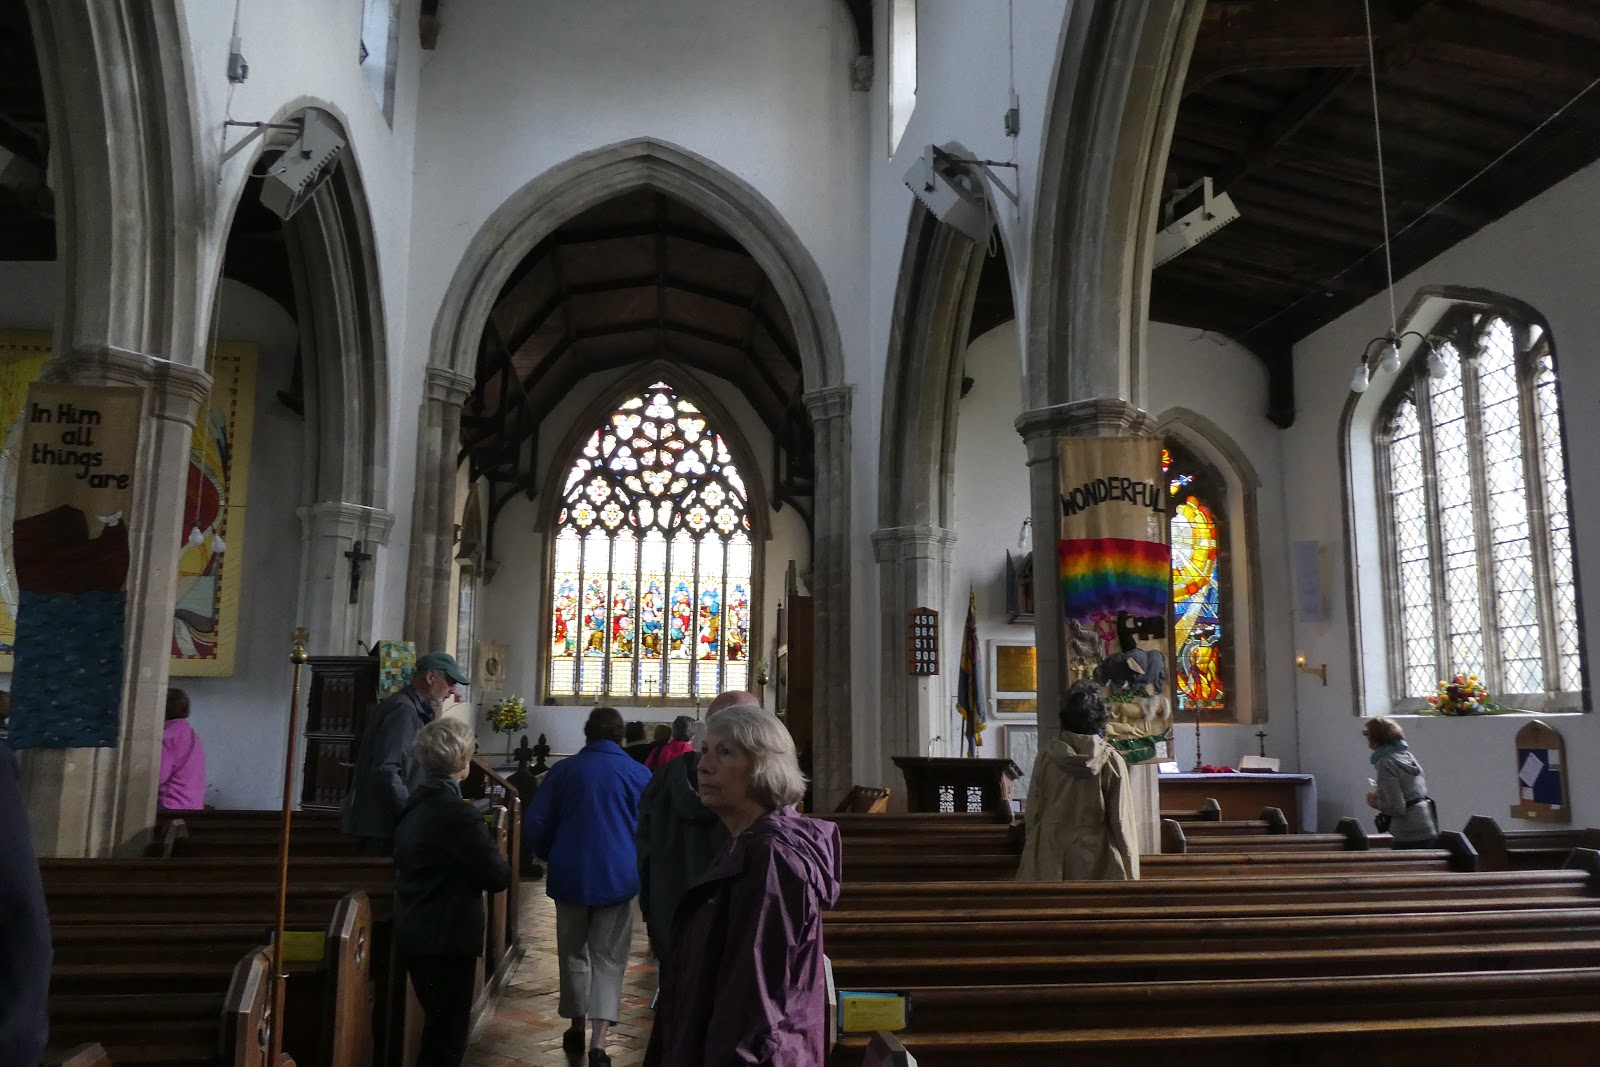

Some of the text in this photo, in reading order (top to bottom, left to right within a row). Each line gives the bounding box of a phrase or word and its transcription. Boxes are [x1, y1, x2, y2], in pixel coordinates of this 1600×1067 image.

[31, 402, 102, 425] In Him
[61, 425, 94, 447] all
[31, 443, 103, 479] things
[89, 473, 130, 489] are
[1060, 476, 1166, 517] WONDERFUL
[914, 615, 935, 625] 450
[914, 627, 935, 637] 964
[915, 639, 934, 649] 511
[915, 651, 936, 661] 900
[915, 662, 936, 673] 719
